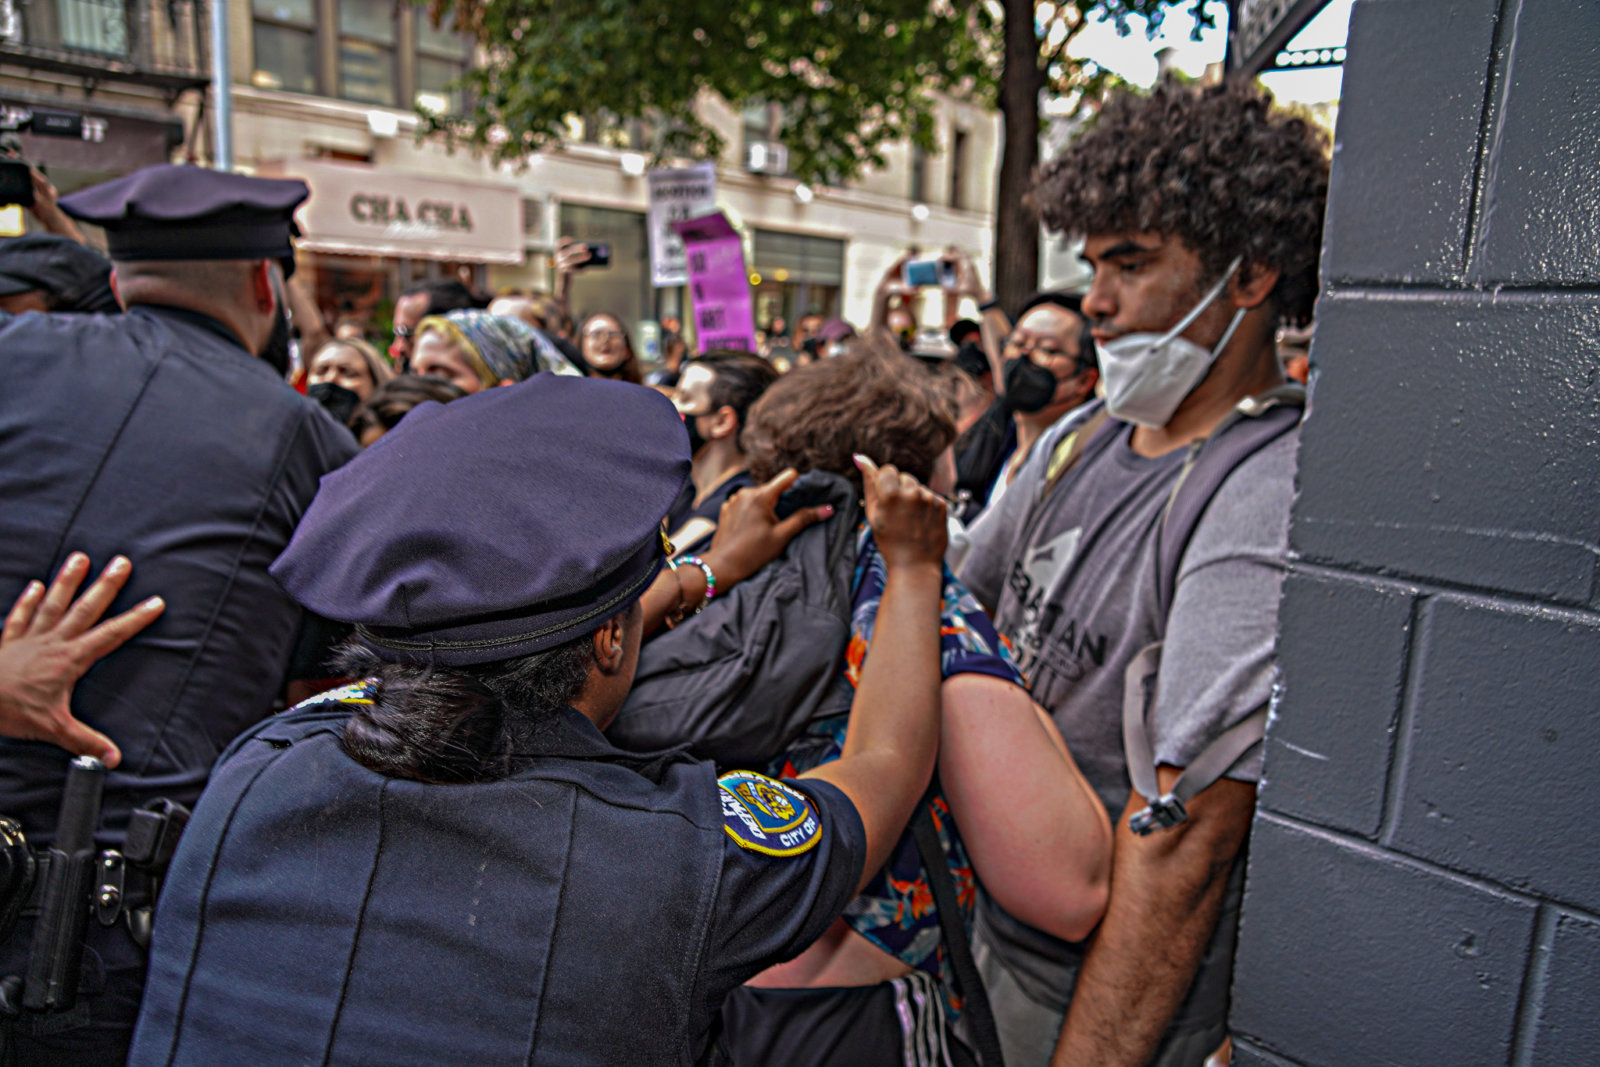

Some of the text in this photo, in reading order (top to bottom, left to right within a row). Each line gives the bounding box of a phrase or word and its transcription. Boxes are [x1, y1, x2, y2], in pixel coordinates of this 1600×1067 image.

[349, 192, 411, 224] CHA
[418, 199, 473, 233] CHA
[780, 827, 806, 847] CITY
